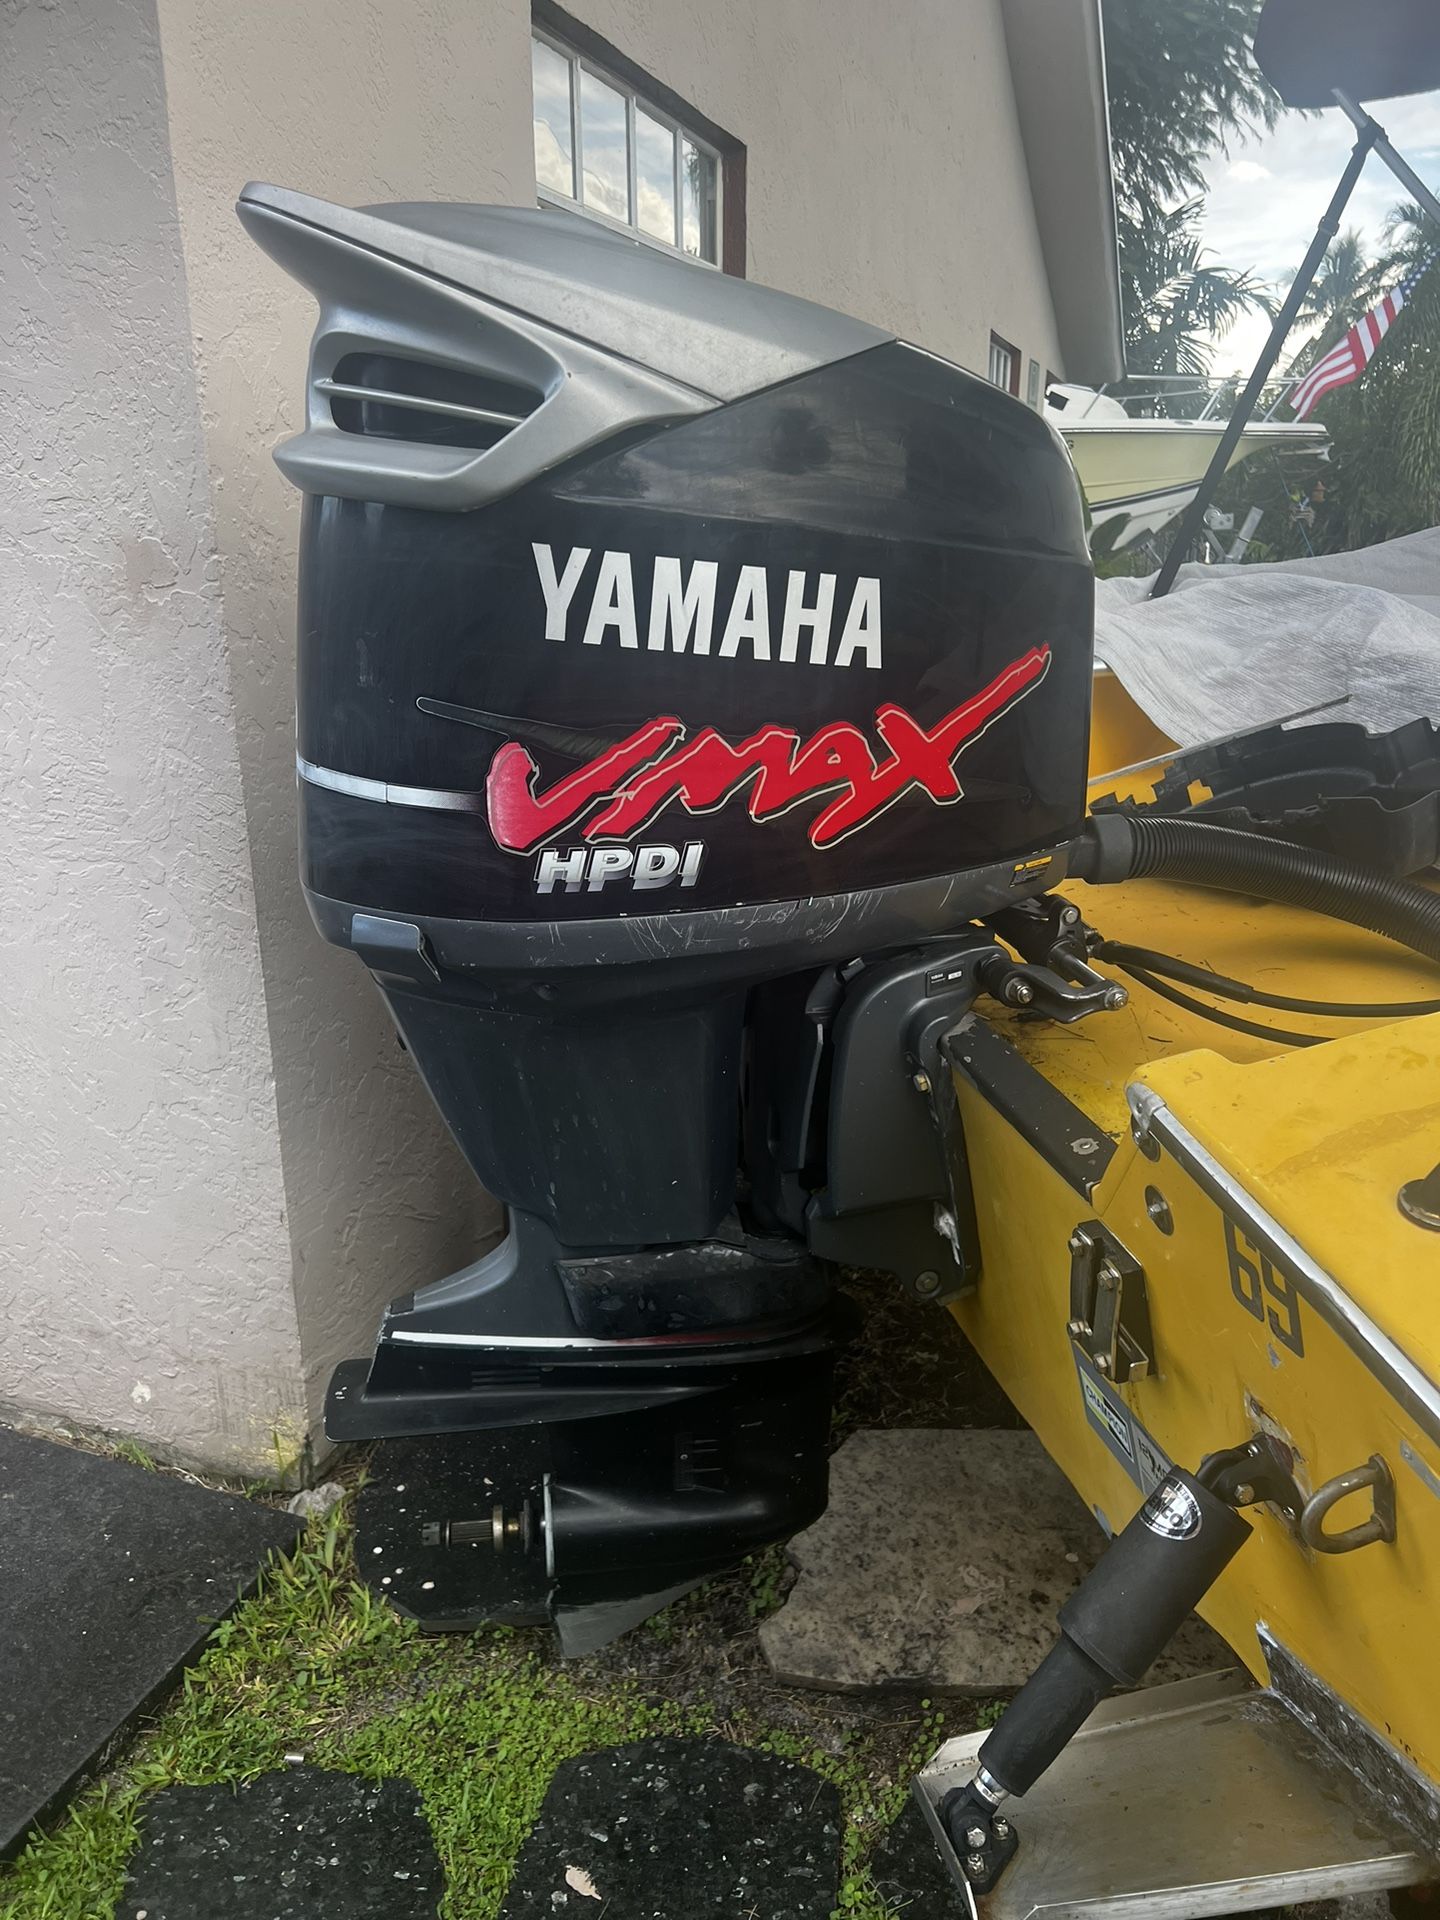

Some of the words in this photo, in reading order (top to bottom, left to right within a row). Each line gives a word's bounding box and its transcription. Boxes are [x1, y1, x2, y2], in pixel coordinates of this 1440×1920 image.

[531, 542, 882, 669] YAMAHA
[533, 840, 705, 894] HPDI
[1222, 1212, 1306, 1359] 69
